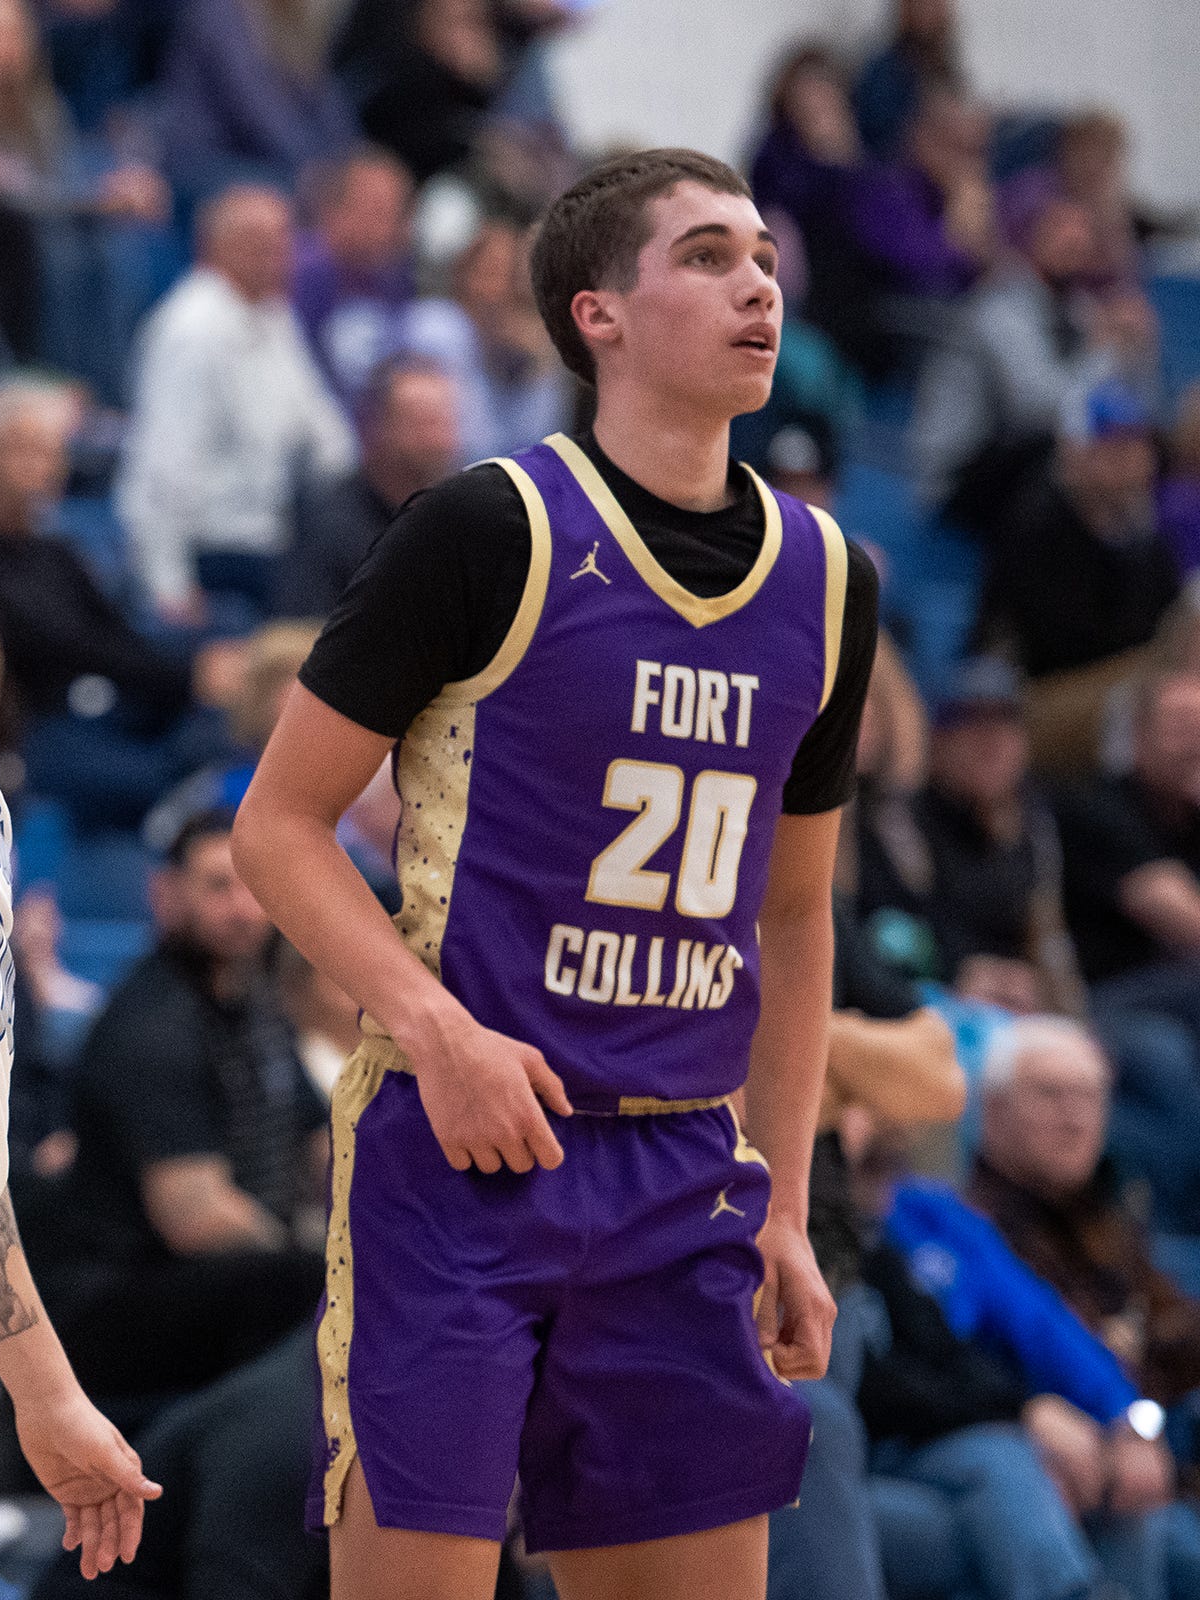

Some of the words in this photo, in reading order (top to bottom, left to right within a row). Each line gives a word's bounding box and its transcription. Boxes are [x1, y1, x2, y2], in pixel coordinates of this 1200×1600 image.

[630, 659, 760, 748] FORT
[585, 757, 757, 919] 20
[544, 923, 744, 1010] COLLINS
